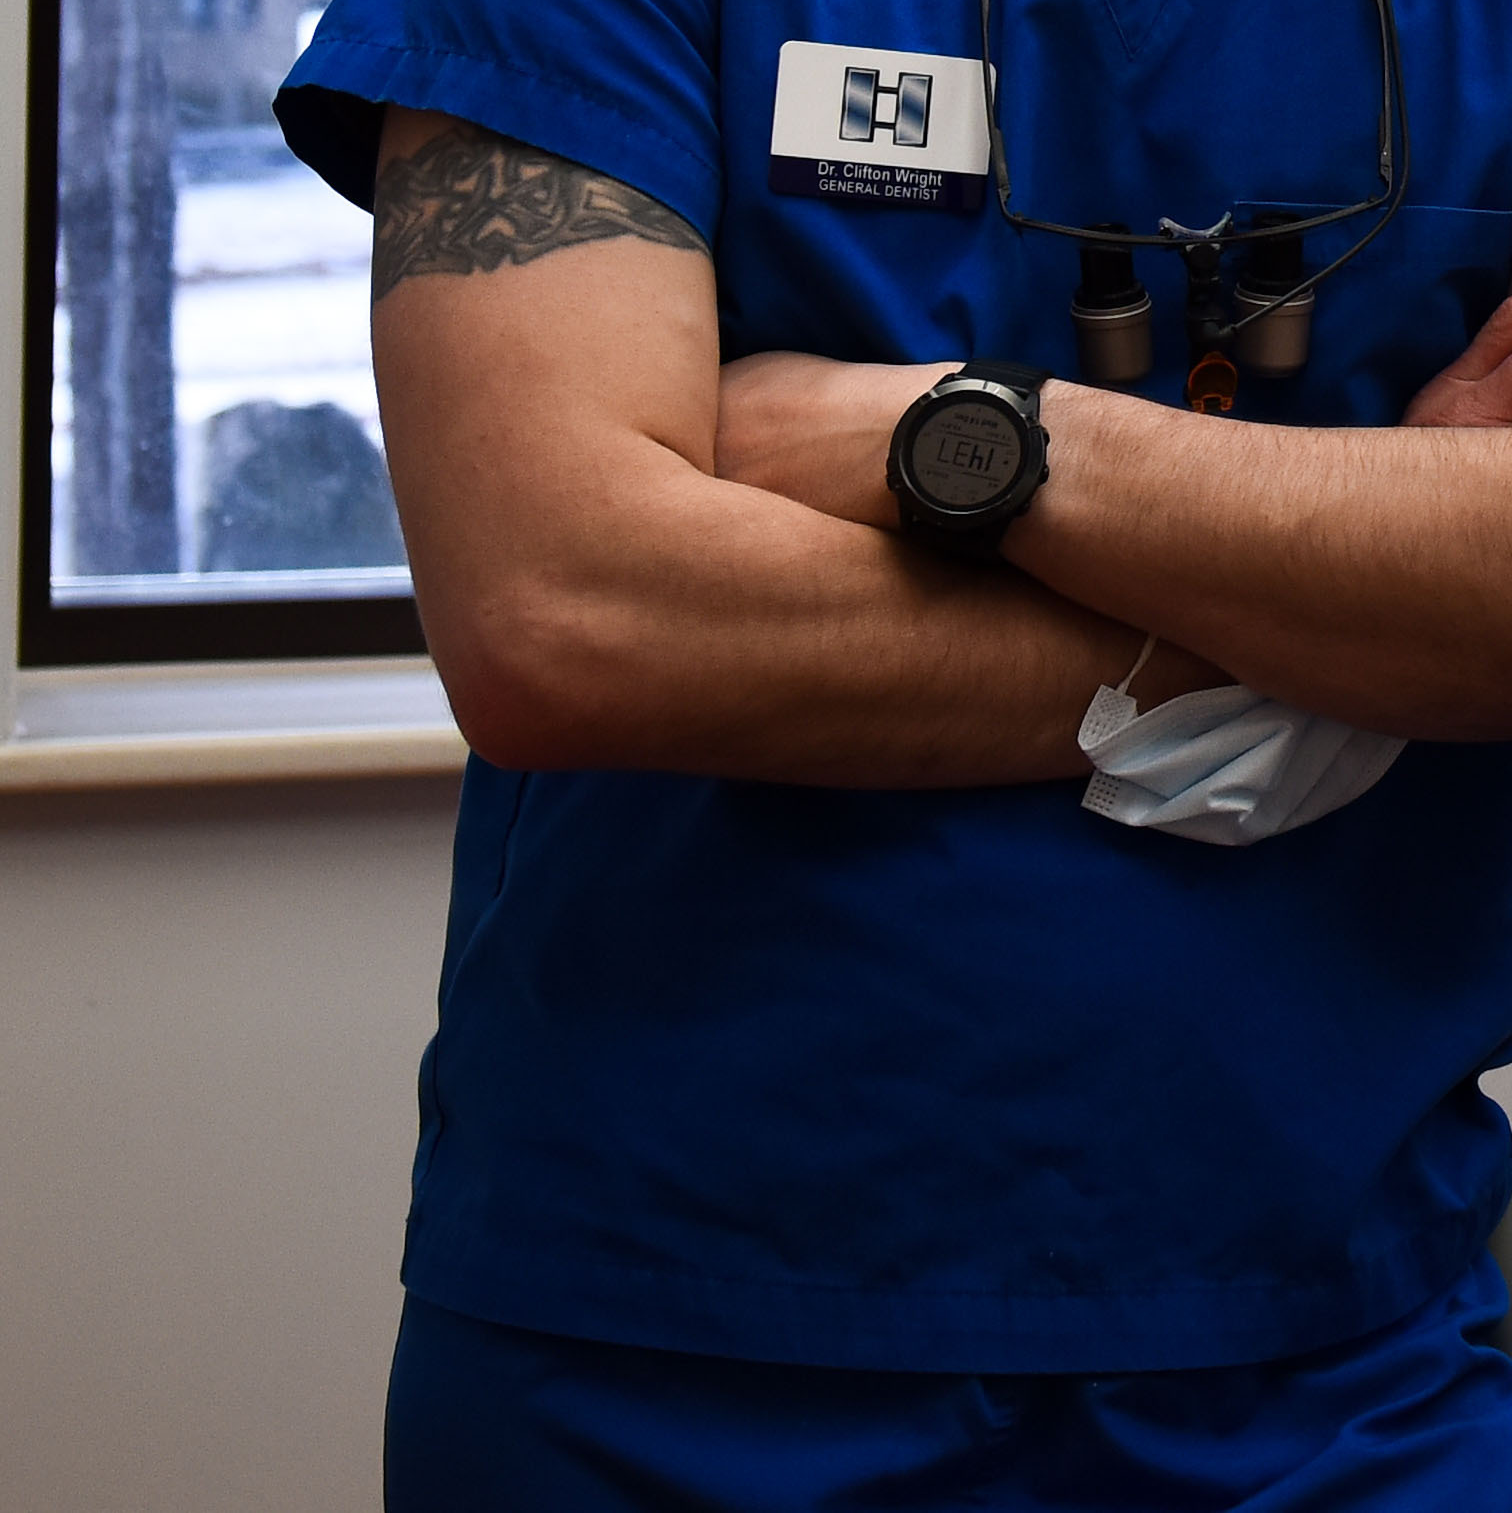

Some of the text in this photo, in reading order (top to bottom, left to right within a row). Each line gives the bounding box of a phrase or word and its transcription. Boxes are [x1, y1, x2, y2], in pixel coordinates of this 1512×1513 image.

[817, 161, 942, 187] Dr. Clifton Wright
[818, 178, 939, 201] GENERAL DENTIST
